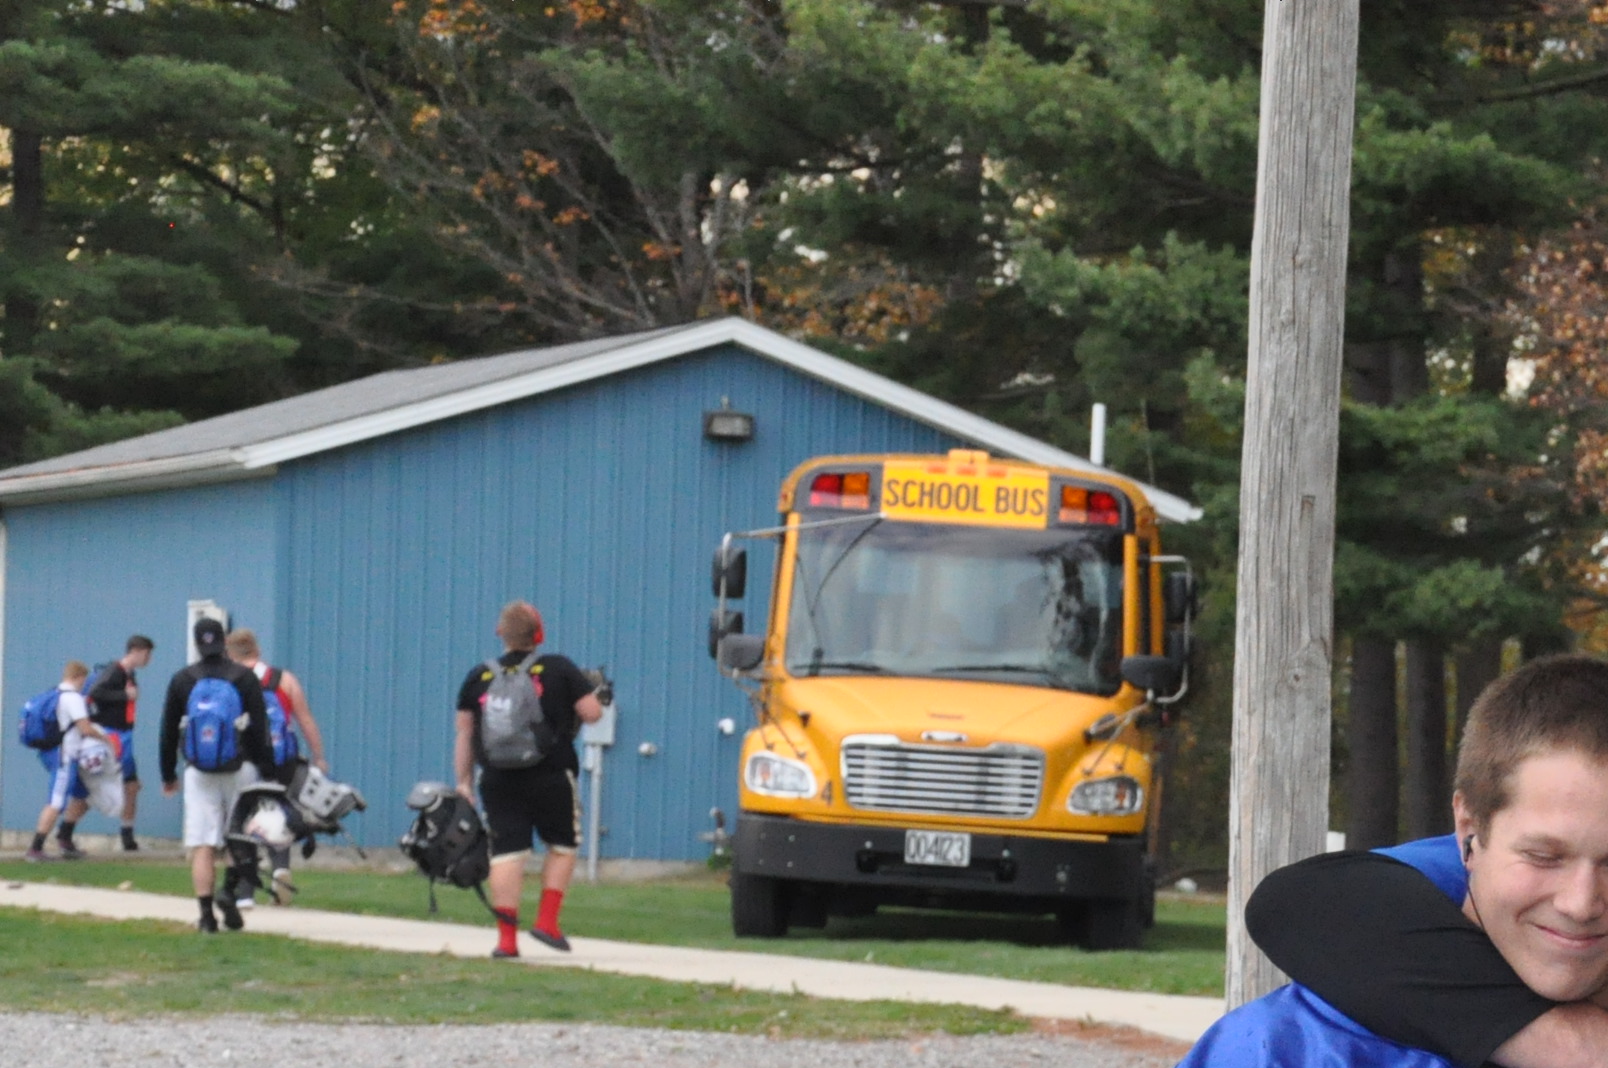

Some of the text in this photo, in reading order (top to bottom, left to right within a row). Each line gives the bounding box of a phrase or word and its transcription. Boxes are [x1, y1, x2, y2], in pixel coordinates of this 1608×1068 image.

[885, 478, 1045, 517] SCHOOL BUS
[820, 779, 833, 806] 4
